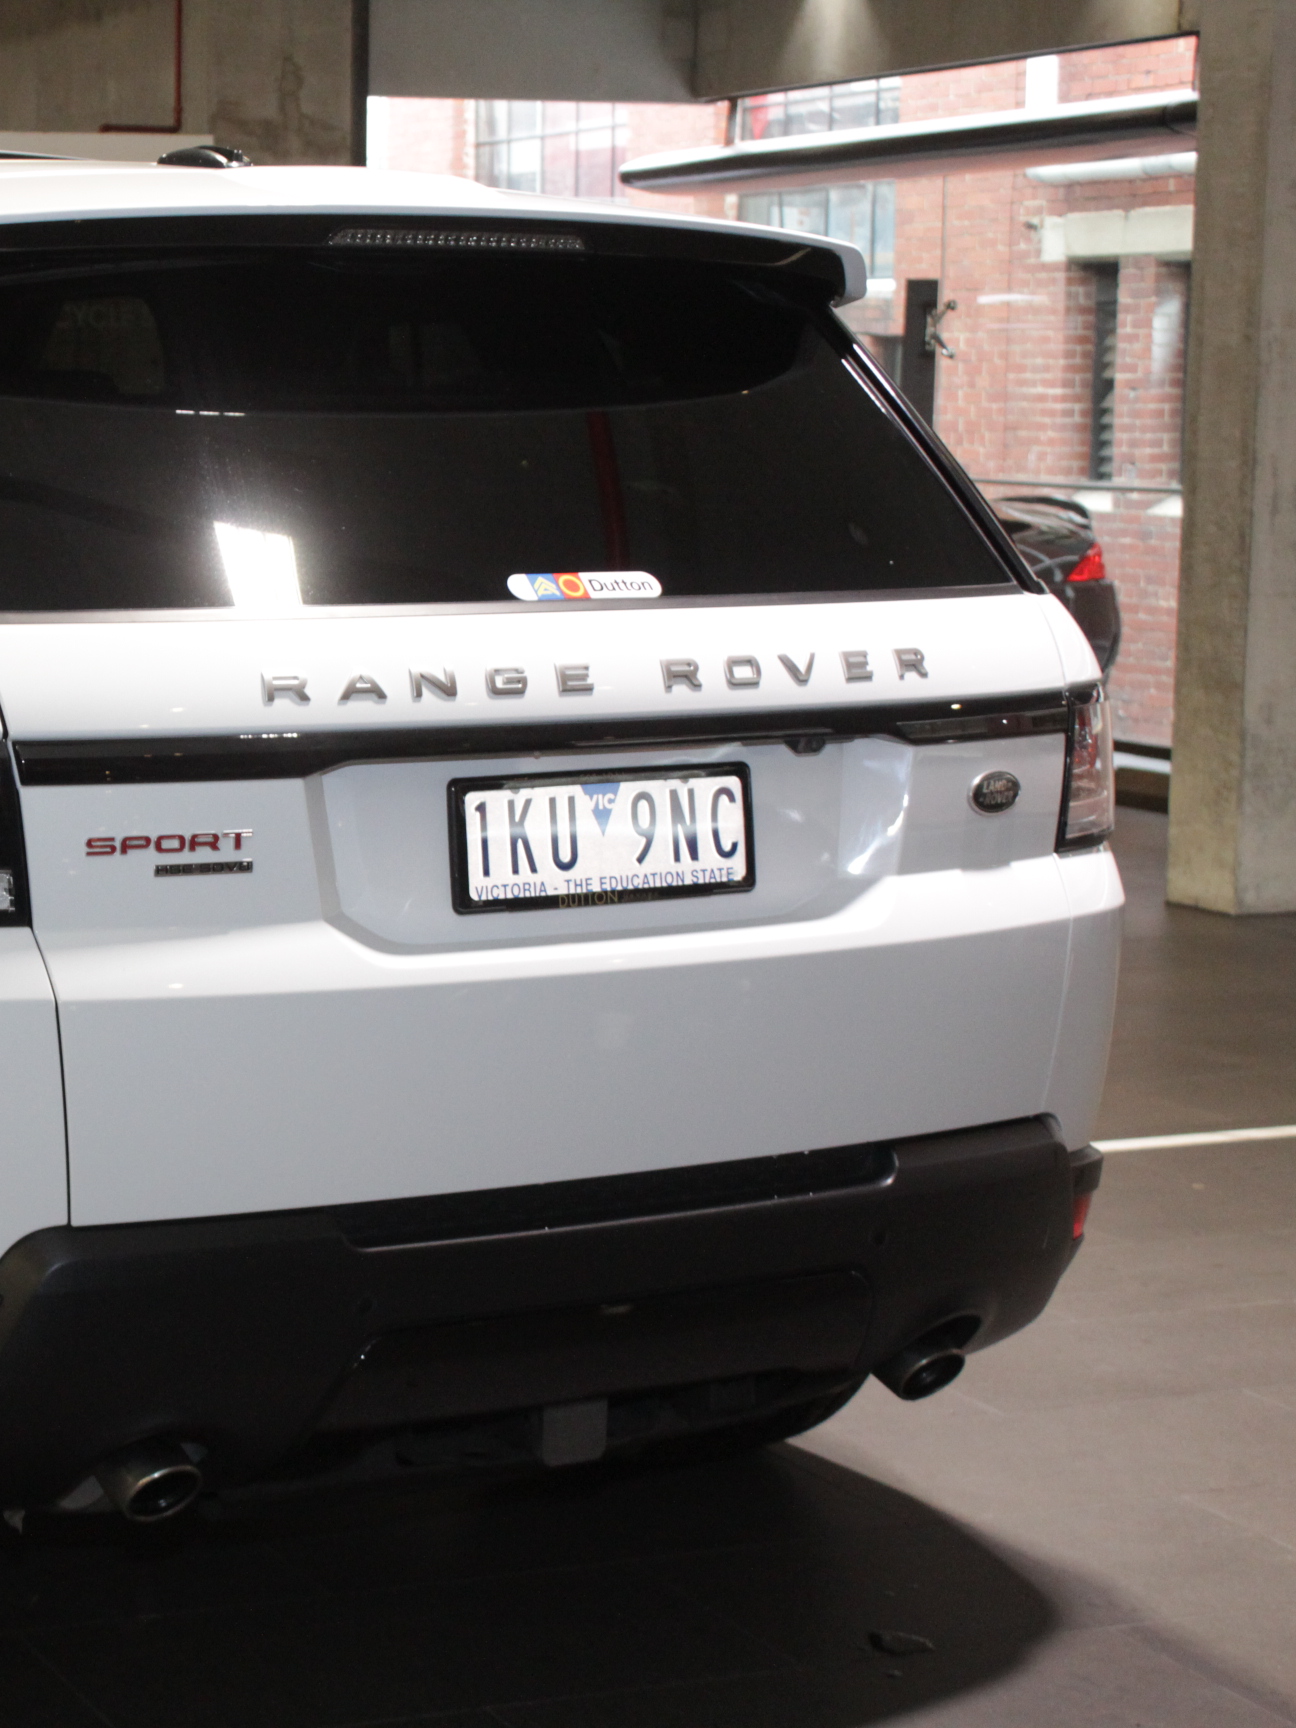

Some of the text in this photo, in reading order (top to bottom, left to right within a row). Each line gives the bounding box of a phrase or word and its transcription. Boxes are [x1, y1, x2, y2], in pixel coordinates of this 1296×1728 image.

[588, 578, 654, 593] Dutton
[261, 648, 929, 704] RANGE ROVER
[584, 793, 616, 812] VIC
[86, 829, 254, 857] SPORT
[474, 786, 739, 878] 1KU 9NC
[475, 881, 548, 900] VICTORIA
[564, 877, 593, 893] THE
[599, 870, 684, 891] EDUCATION
[690, 867, 735, 884] STATE
[559, 890, 618, 908] DUTTON
